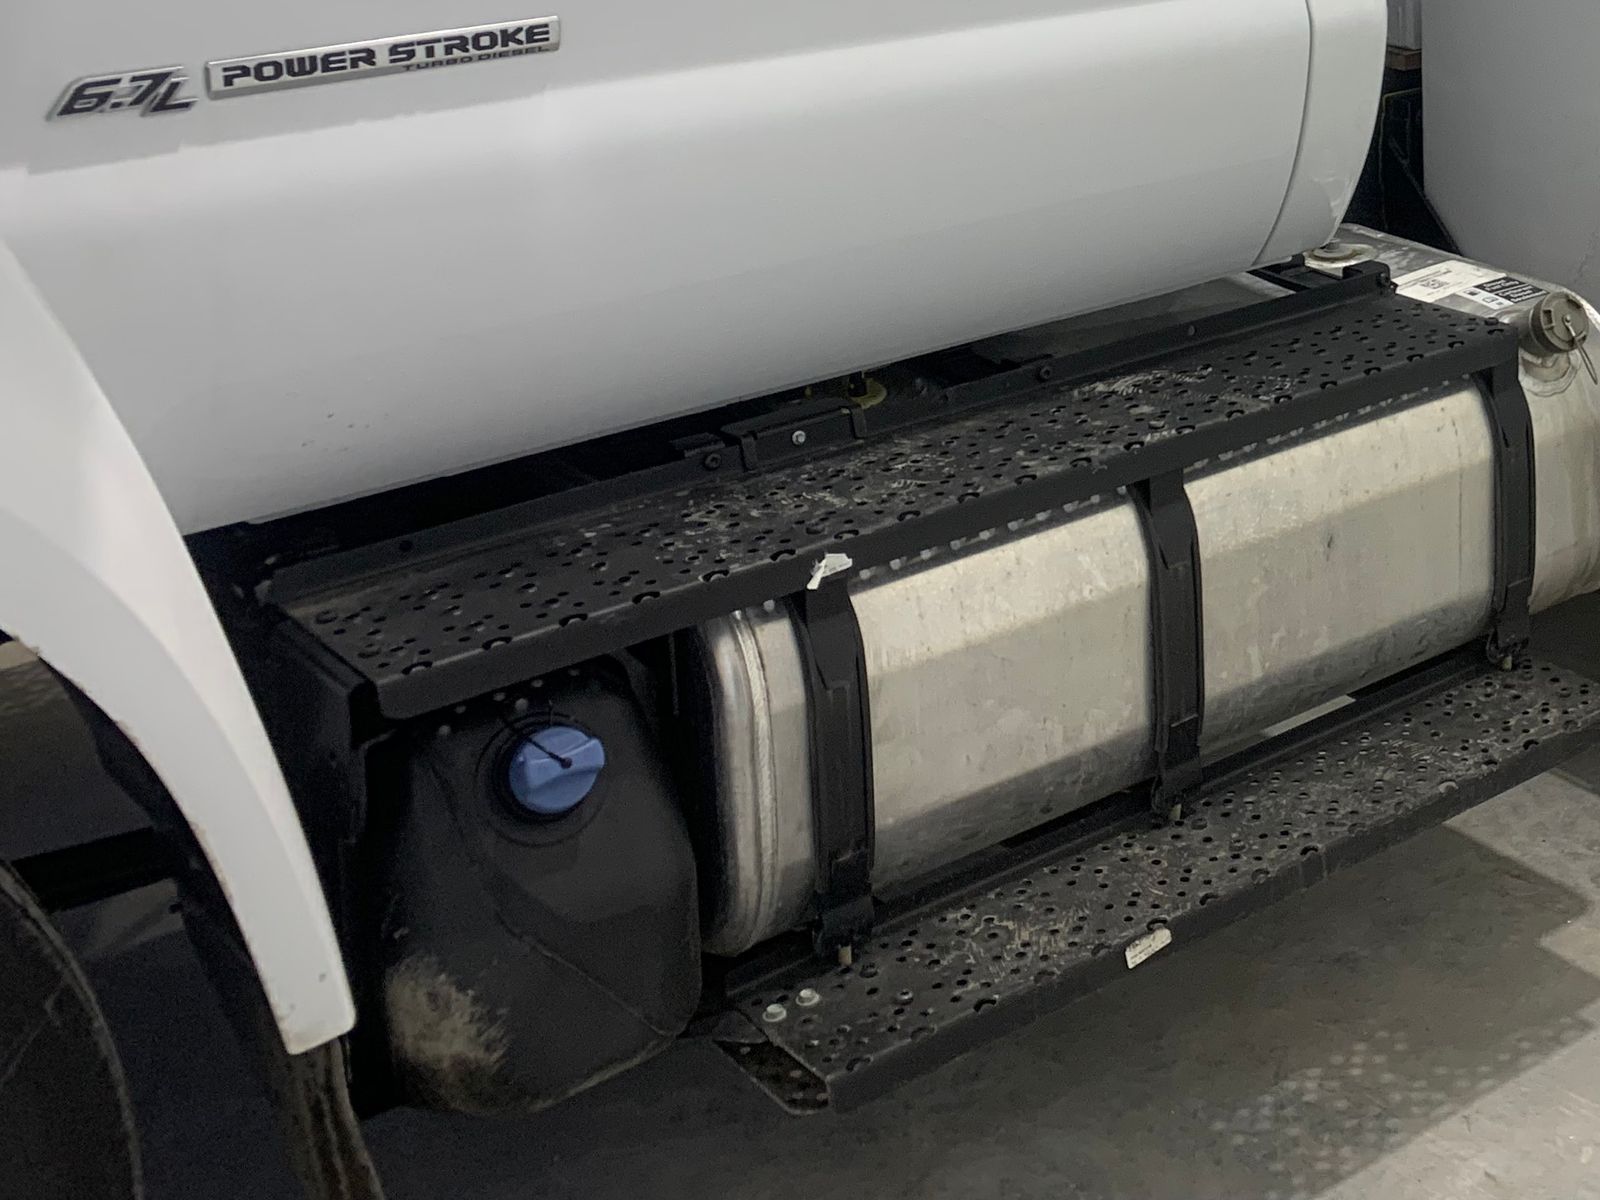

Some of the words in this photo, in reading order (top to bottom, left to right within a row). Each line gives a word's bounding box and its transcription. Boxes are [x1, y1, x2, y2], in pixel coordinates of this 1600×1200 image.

[222, 49, 377, 87] POWER
[388, 23, 550, 64] STROKE
[402, 56, 474, 71] TURBO
[477, 46, 551, 61] DIESEL
[46, 67, 198, 121] 6.7L
